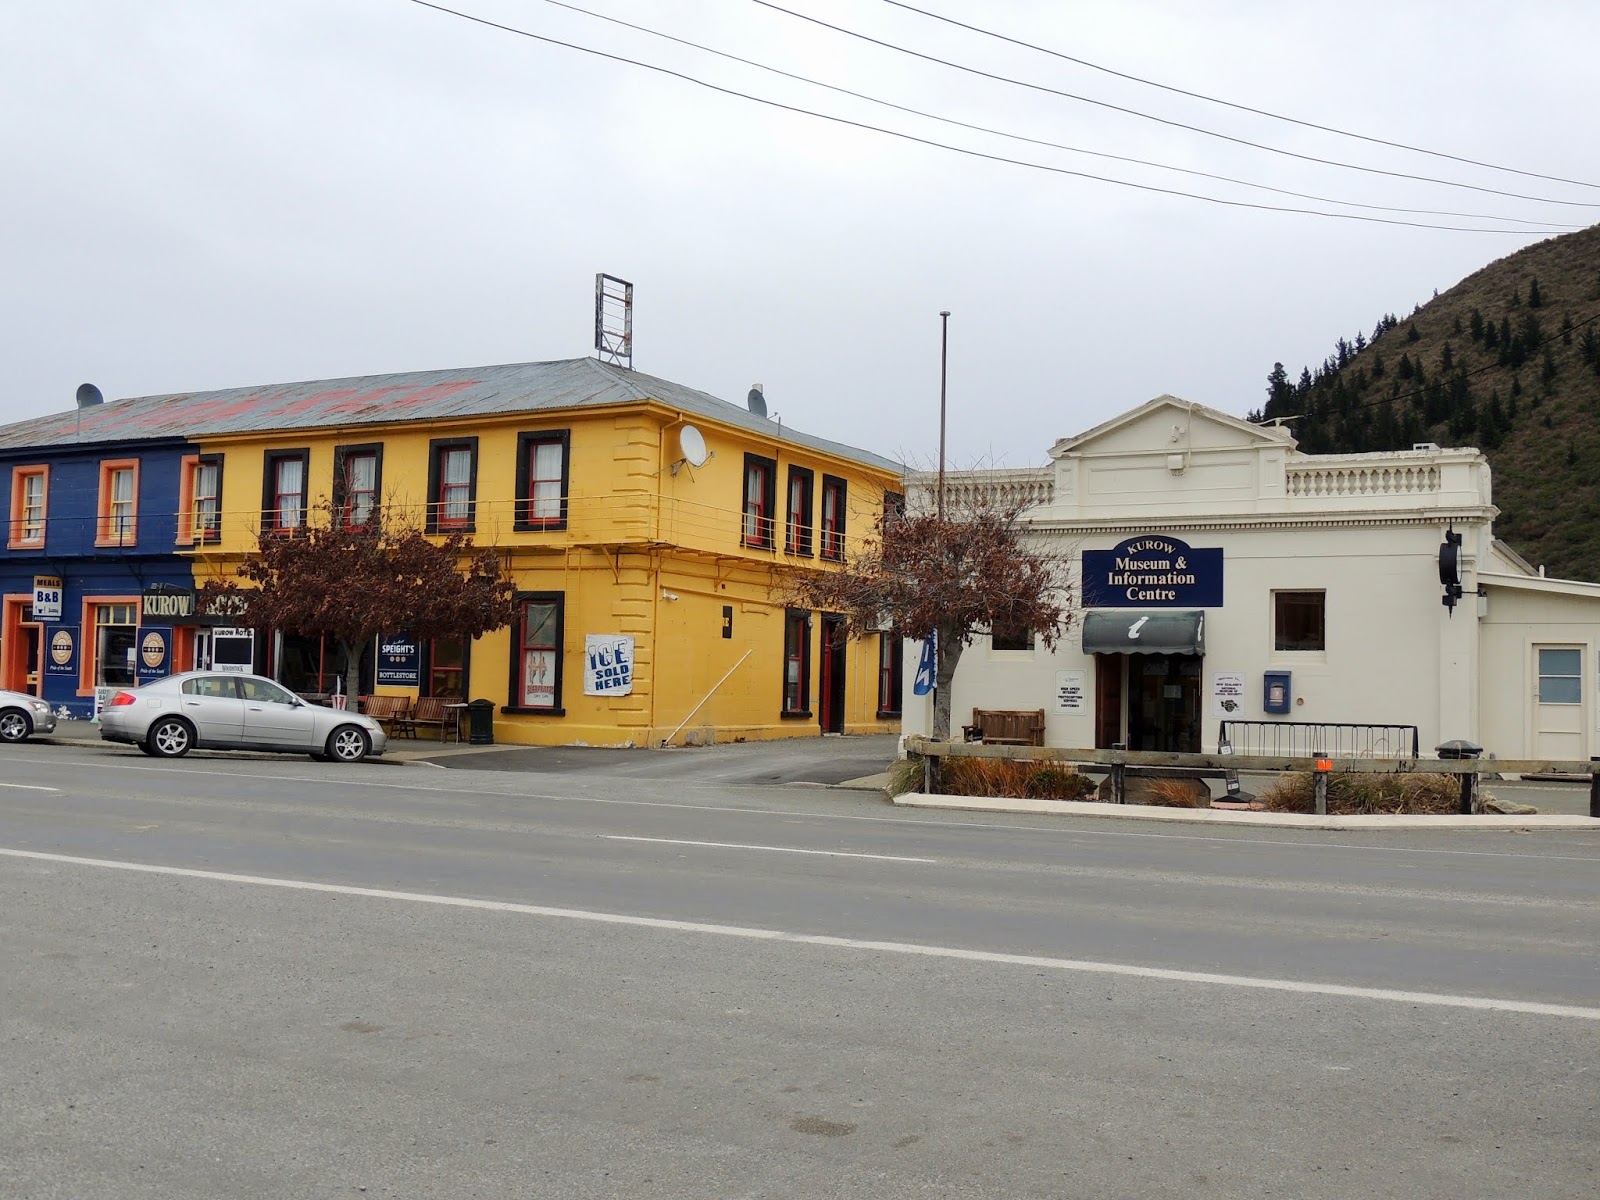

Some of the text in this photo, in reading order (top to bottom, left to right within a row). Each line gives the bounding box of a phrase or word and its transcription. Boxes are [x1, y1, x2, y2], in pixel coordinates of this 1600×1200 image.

[1127, 540, 1176, 555] KUROW
[1115, 556, 1187, 570] Museum &
[36, 579, 60, 587] MEALS
[1108, 571, 1195, 585] Information
[37, 591, 59, 602] B&B
[1126, 587, 1176, 600] Centre
[143, 595, 191, 616] KUROW
[382, 644, 415, 654] SPEIGHT'S
[588, 639, 629, 670] ICE
[379, 671, 417, 679] BOTTLESTORE
[595, 665, 629, 679] SOLD
[595, 675, 631, 691] HERE
